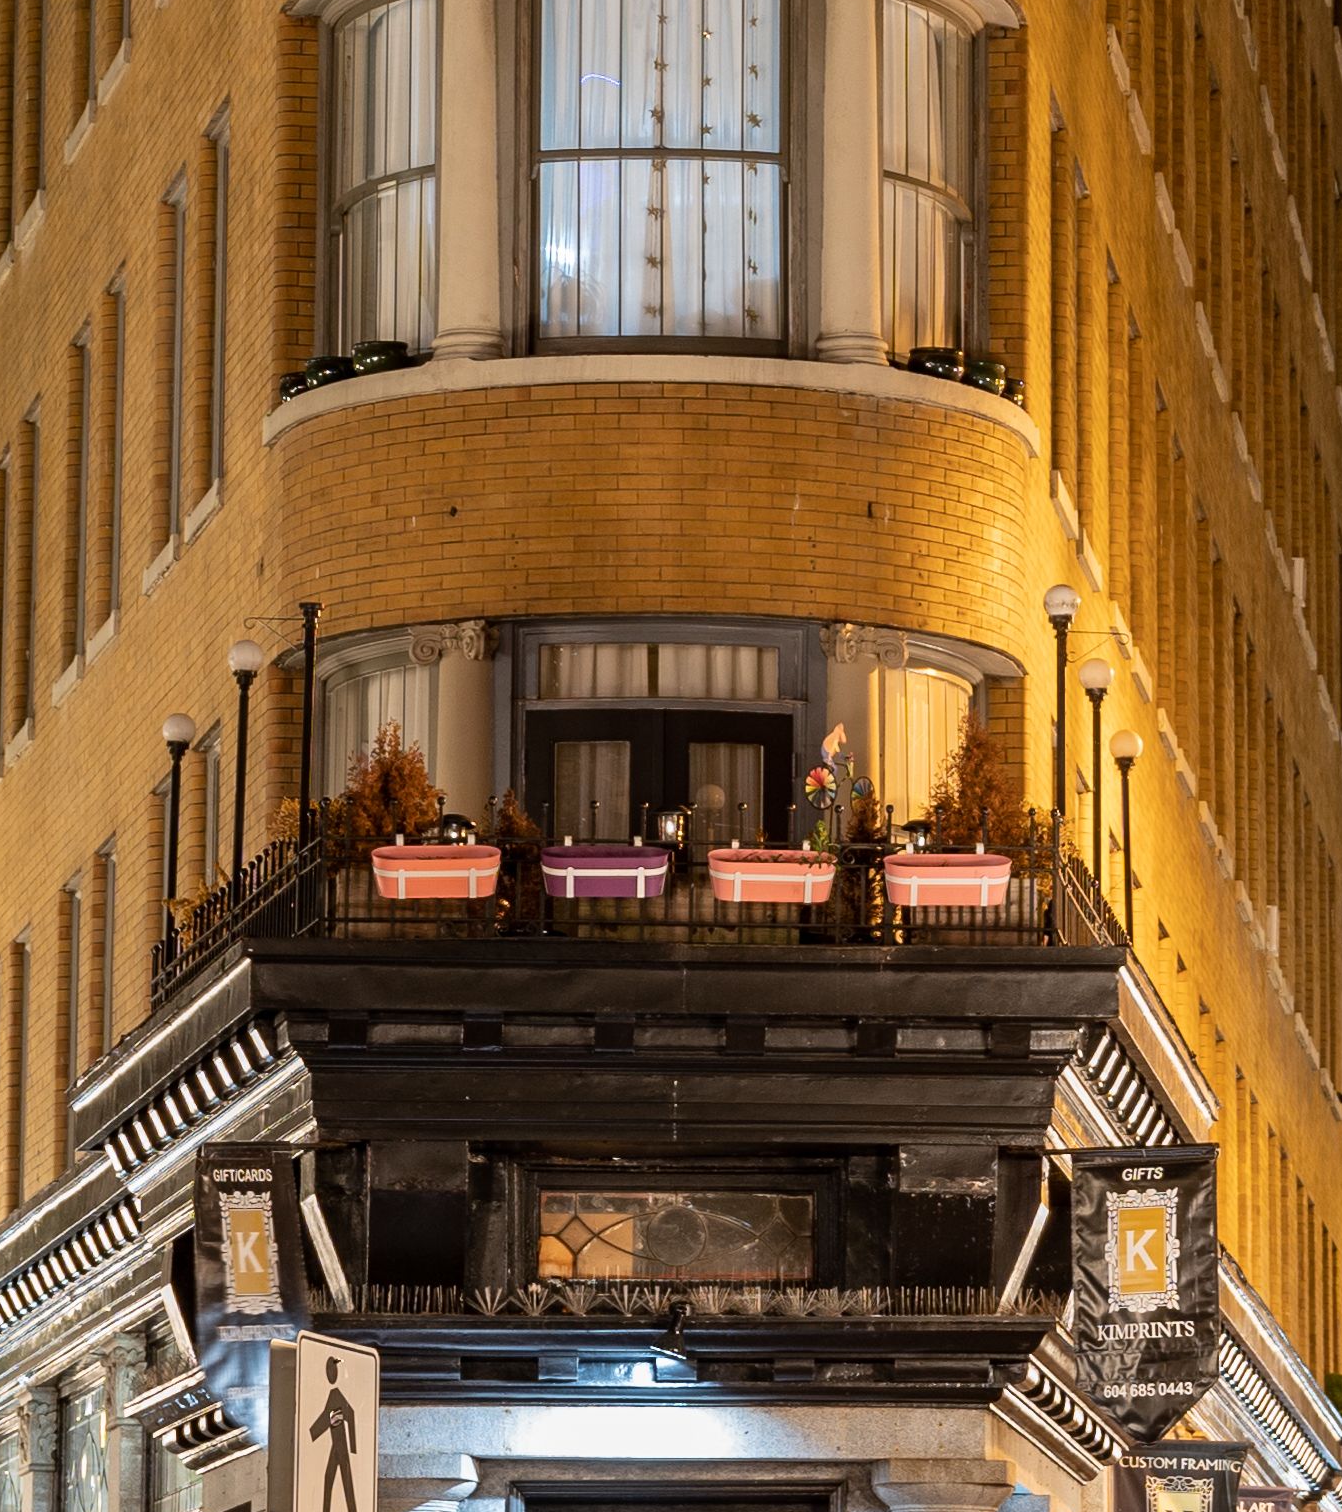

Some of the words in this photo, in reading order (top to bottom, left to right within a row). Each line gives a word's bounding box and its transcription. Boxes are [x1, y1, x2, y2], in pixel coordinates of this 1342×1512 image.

[1121, 1166, 1164, 1182] GIFTS
[237, 1231, 264, 1273] K
[1125, 1229, 1158, 1272] K
[1097, 1320, 1196, 1342] KIMPRINTS
[1103, 1384, 1127, 1399] 604
[1129, 1383, 1156, 1397] 685
[1158, 1381, 1194, 1396] 0443
[1118, 1456, 1178, 1470] CUSTOM
[1180, 1457, 1242, 1474] FRAMING
